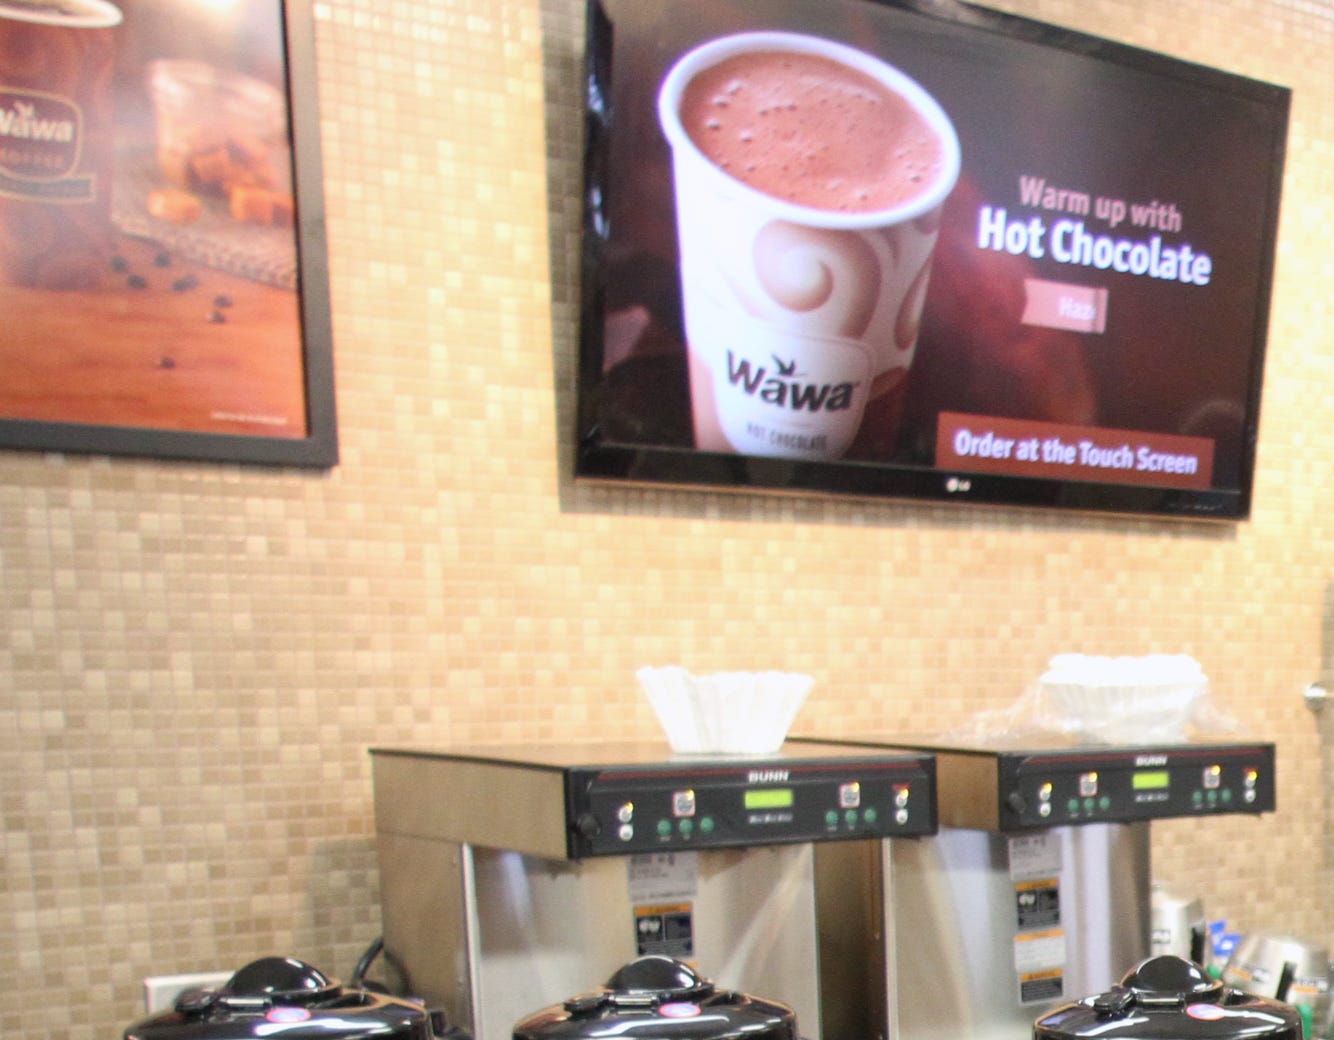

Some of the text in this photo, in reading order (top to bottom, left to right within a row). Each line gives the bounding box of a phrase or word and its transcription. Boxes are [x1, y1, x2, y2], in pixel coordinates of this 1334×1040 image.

[1020, 174, 1183, 233] Warm up with
[978, 205, 1213, 286] Hot Chocolate
[727, 349, 856, 412] Wawa
[955, 428, 1199, 475] Order at the Touch Screen
[749, 770, 790, 783] BUNN
